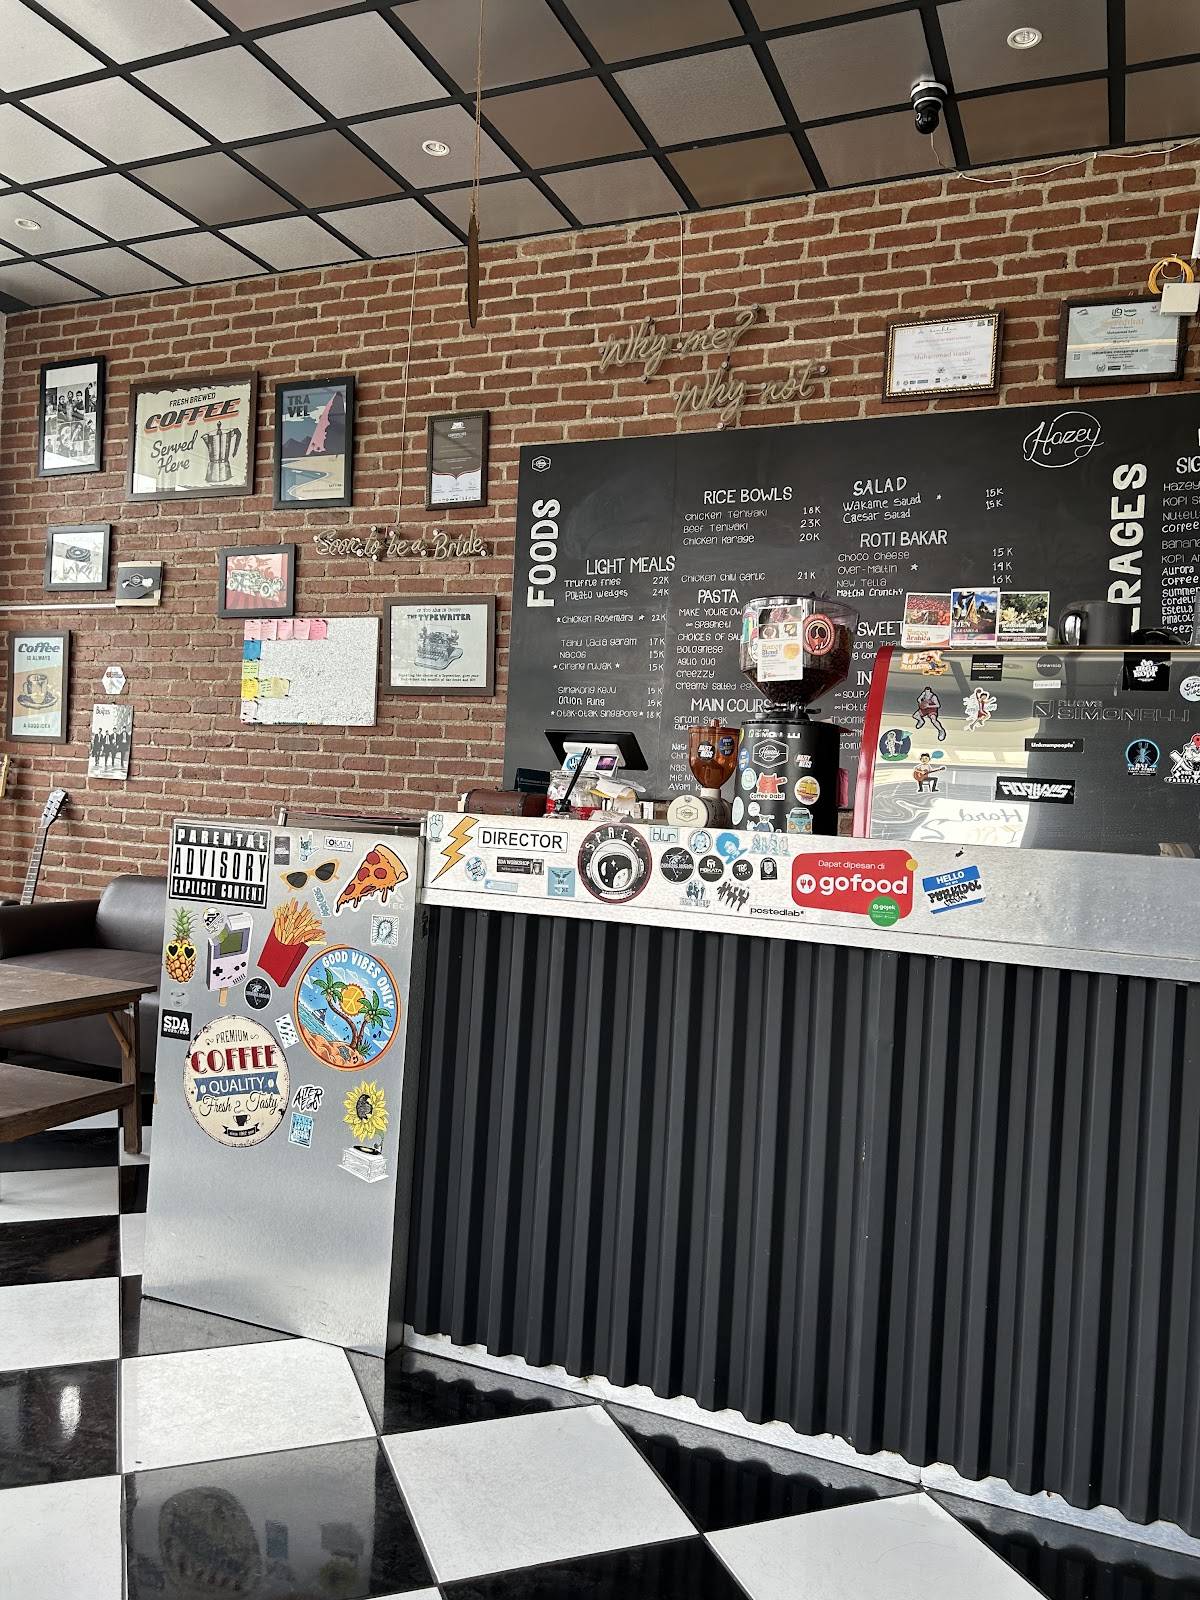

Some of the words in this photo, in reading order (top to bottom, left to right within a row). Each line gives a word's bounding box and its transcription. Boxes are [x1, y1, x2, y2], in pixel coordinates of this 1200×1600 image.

[169, 397, 188, 406] FRESH
[189, 392, 216, 404] BREWED
[287, 394, 311, 406] TRA
[143, 398, 241, 433] COFFEE
[288, 406, 309, 418] VEL
[150, 430, 199, 459] Served
[157, 456, 190, 475] Here
[1176, 456, 1200, 474] SIG
[853, 476, 907, 496] SALAD
[704, 489, 736, 504] RICE
[740, 486, 793, 503] BOWLS
[842, 499, 889, 511] Wakame
[985, 487, 1004, 498] 15K
[803, 506, 821, 515] 18K
[842, 511, 880, 524] Caesar
[800, 519, 822, 528] 23K
[800, 533, 820, 542] 20K
[860, 532, 896, 548] ROTI
[900, 529, 948, 547] BAKAR
[386, 534, 407, 554] be
[432, 531, 483, 560] Bride
[526, 498, 561, 607] FOODS
[992, 547, 1014, 557] 15K
[1107, 463, 1148, 632] RAGES
[586, 558, 625, 576] LIGHT
[630, 556, 676, 574] MEALS
[652, 576, 670, 585] 22K
[797, 572, 816, 580] 21K
[992, 574, 1012, 585] 16K
[652, 588, 669, 596] 24K
[698, 589, 739, 604] PASTA
[652, 613, 666, 622] 22K
[678, 608, 700, 617] MAKE
[730, 608, 742, 616] OW
[649, 638, 666, 646] 17K
[678, 632, 712, 642] CHOICES
[714, 632, 726, 640] OF
[18, 642, 61, 653] Coffee
[648, 664, 664, 672] 15K
[690, 698, 724, 712] MAIN
[726, 698, 772, 713] COURS
[176, 827, 266, 849] PARENTAL
[482, 830, 563, 850] DIRECTOR
[652, 828, 677, 842] blur
[173, 848, 267, 883] ADVISORY
[818, 860, 844, 870] Dapat
[846, 860, 874, 871] dipesan
[820, 874, 909, 896] gofood
[936, 871, 965, 885] HELLO
[173, 879, 216, 897] EXPLICIT
[222, 884, 264, 902] CONTENT
[322, 952, 348, 968] GOOD
[352, 952, 381, 980] VIBES
[376, 978, 395, 1010] ONLY
[163, 1014, 190, 1032] SDA
[216, 1029, 249, 1044] PREMIUM
[190, 1044, 278, 1074] COFFEE
[208, 1077, 265, 1094] QUALITY
[200, 1094, 232, 1116] Fresh
[246, 1091, 278, 1116] Tasty
